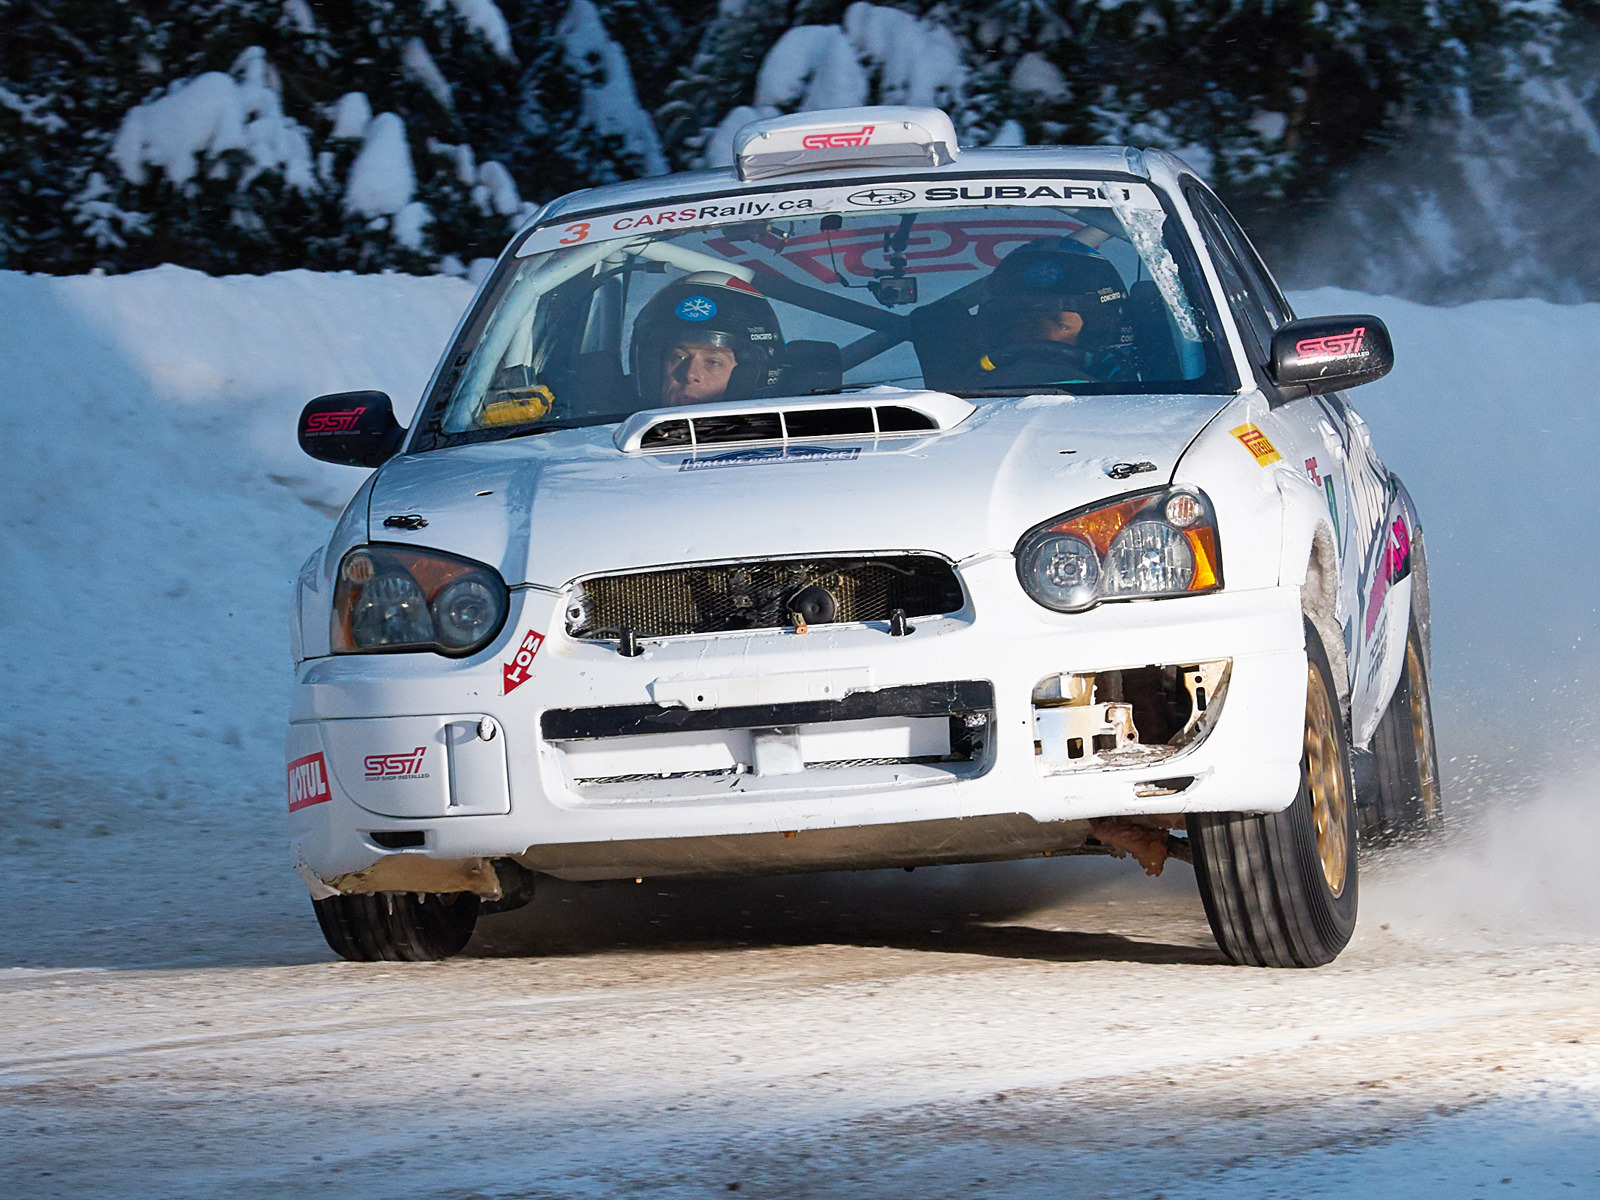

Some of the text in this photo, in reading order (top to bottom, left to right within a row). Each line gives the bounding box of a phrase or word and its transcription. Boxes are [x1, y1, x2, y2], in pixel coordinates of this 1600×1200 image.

[560, 199, 813, 244] 3 CARSRally.ca
[1237, 429, 1275, 458] PIRELLI
[506, 635, 541, 683] TOW
